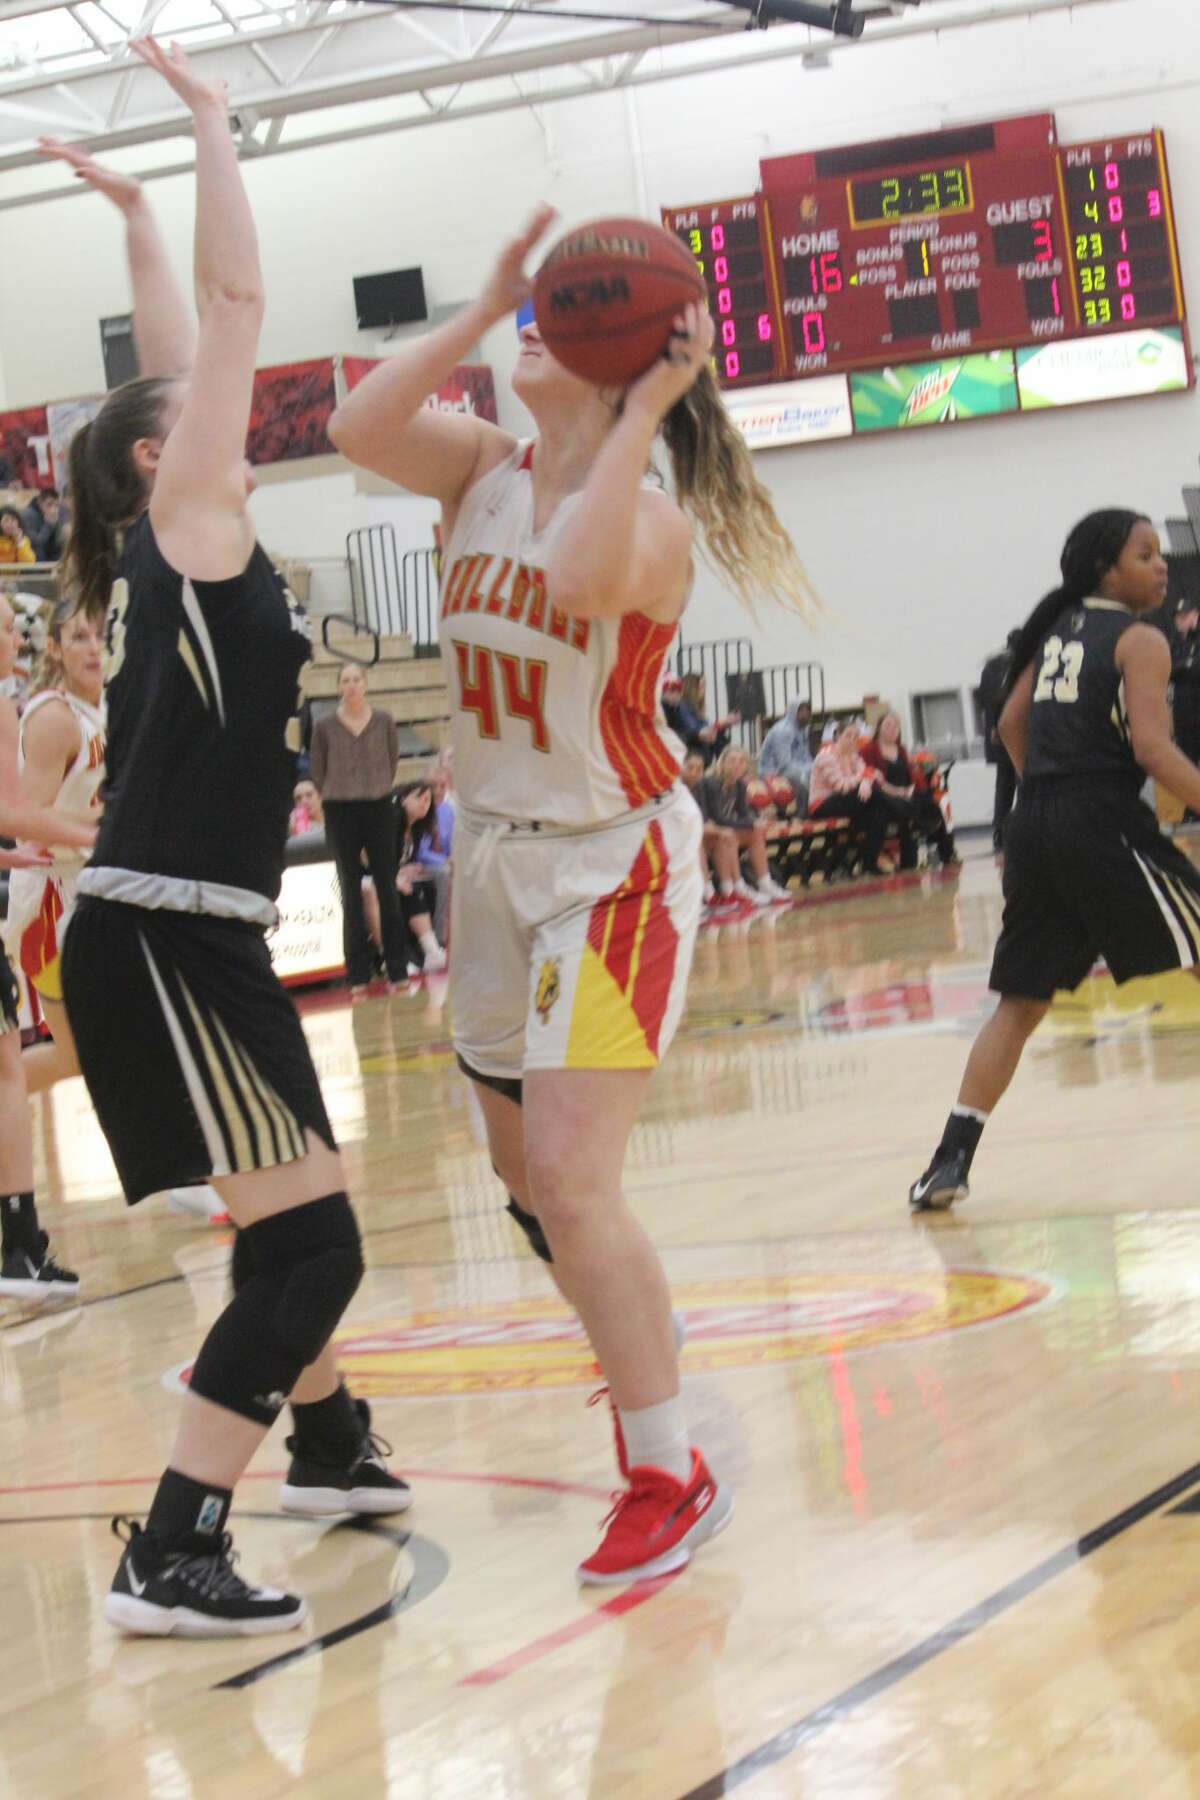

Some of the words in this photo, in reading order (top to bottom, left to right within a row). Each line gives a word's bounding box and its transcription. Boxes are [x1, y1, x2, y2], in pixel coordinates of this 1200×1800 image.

[1127, 139, 1152, 158] PTS
[1089, 168, 1095, 192] 1
[1104, 162, 1119, 189] 0
[882, 168, 965, 217] 2:33
[732, 201, 756, 219] PTS
[987, 195, 1053, 226] GUEST
[1084, 200, 1099, 224] 4
[1108, 195, 1122, 222] 0
[1147, 190, 1160, 216] 3
[711, 224, 724, 250] 0
[782, 229, 840, 258] HOME
[889, 222, 940, 244] PERIOD
[930, 231, 978, 255] BONUS
[1032, 219, 1052, 261] 3
[1076, 232, 1103, 260] 23
[1120, 228, 1127, 253] 1
[714, 256, 728, 282] 0
[856, 244, 904, 266] BONUS
[921, 240, 929, 277] 1
[941, 252, 980, 272] POSS
[1017, 257, 1063, 281] FOULS
[809, 251, 842, 294] 16
[859, 265, 897, 286] POSS
[885, 278, 938, 300] PLAYER
[945, 272, 979, 291] FOUL
[1079, 265, 1106, 293] 32
[1116, 260, 1131, 287] 0
[718, 288, 731, 314] 0
[784, 294, 828, 315] FOULS
[1051, 277, 1061, 315] 1
[1084, 298, 1111, 325] 33
[1120, 293, 1135, 320] 0
[722, 319, 736, 346] 0
[758, 314, 771, 341] 6
[803, 312, 825, 353] 0
[931, 329, 971, 351] GAME
[1031, 316, 1064, 336] WON
[725, 351, 739, 377] 0
[795, 352, 828, 371] WON
[1034, 635, 1084, 703] 23
[451, 638, 550, 754] 44
